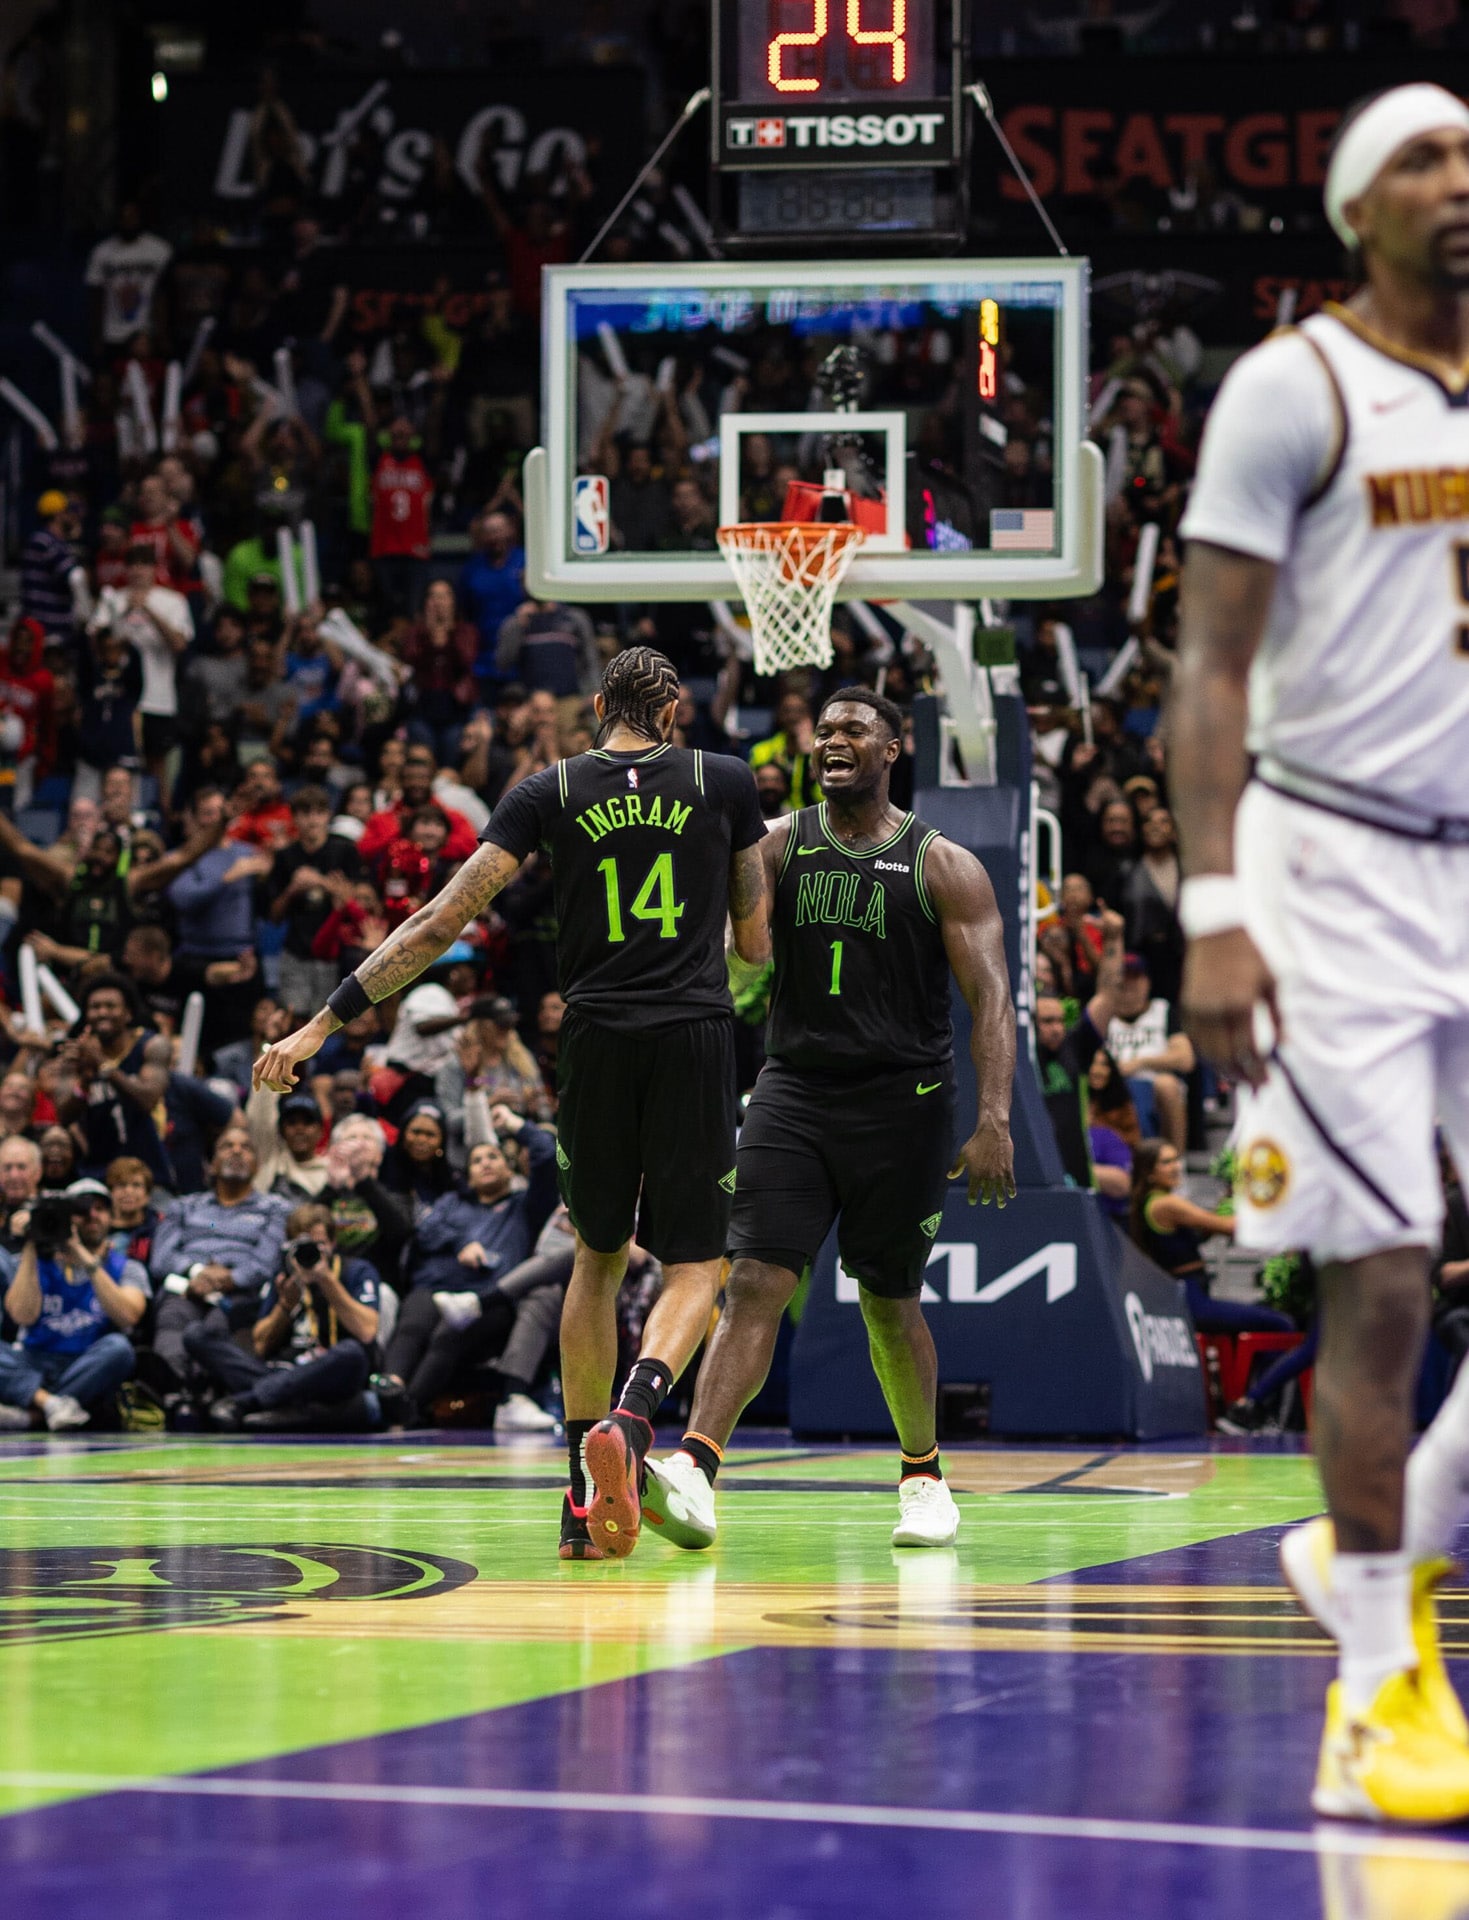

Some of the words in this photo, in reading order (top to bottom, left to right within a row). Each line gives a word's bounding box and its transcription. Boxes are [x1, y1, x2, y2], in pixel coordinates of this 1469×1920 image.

[768, 0, 906, 91] 24
[215, 104, 433, 197] Lt's
[787, 114, 944, 147] TISSOT
[575, 794, 693, 843] INGRAM
[874, 859, 910, 873] ibotta
[597, 853, 684, 942] 14
[795, 871, 886, 939] NOLA
[830, 941, 843, 995] 1
